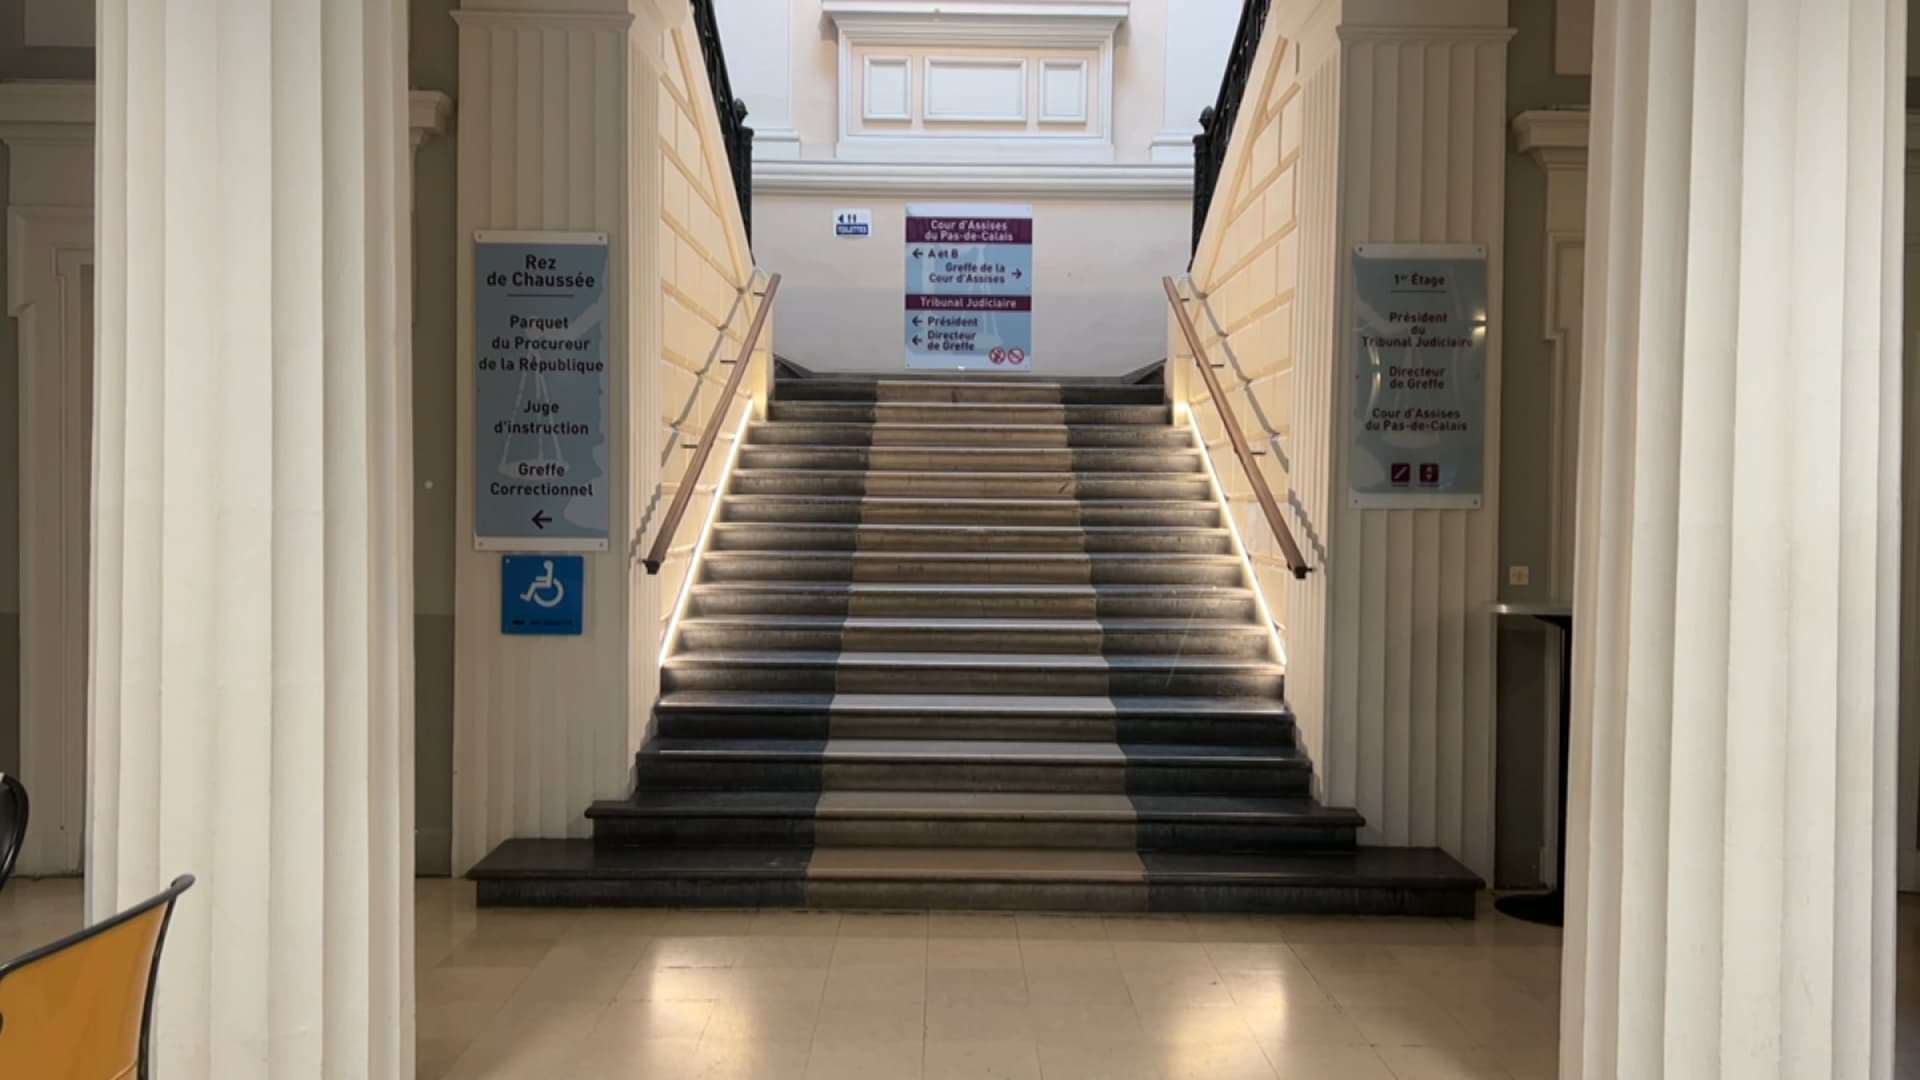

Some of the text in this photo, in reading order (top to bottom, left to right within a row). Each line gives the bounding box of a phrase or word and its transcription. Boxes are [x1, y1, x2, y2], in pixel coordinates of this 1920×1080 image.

[930, 220, 1008, 230] Cour d'Assises
[924, 231, 1014, 241] du Pas-de-Calais
[927, 249, 959, 259] A et B
[525, 254, 557, 270] Rez
[945, 262, 1006, 273] Greffe de la
[487, 271, 595, 288] de Chaussée
[929, 272, 1006, 284] Cour d'Assises
[1411, 272, 1446, 288] Étage
[920, 296, 1017, 308] Tribunal Judiciaire
[509, 315, 569, 331] Parquet
[927, 316, 978, 327] Président
[1389, 311, 1448, 323] Président
[927, 330, 976, 341] Directeur
[1410, 326, 1426, 336] du
[491, 336, 591, 350] du Procureur
[927, 342, 975, 352] de Greffe
[1362, 336, 1412, 347] Tribunal
[478, 356, 604, 374] de la République
[1389, 366, 1446, 377] Directeur
[1389, 379, 1445, 390] de Greffe
[523, 400, 560, 416] Juge
[1372, 407, 1461, 419] Cour d'Assises
[494, 420, 589, 435] d'instruction
[1365, 421, 1468, 432] du Pas-de-Calais
[518, 462, 566, 477] Greffe
[490, 482, 593, 496] Correctionnel
